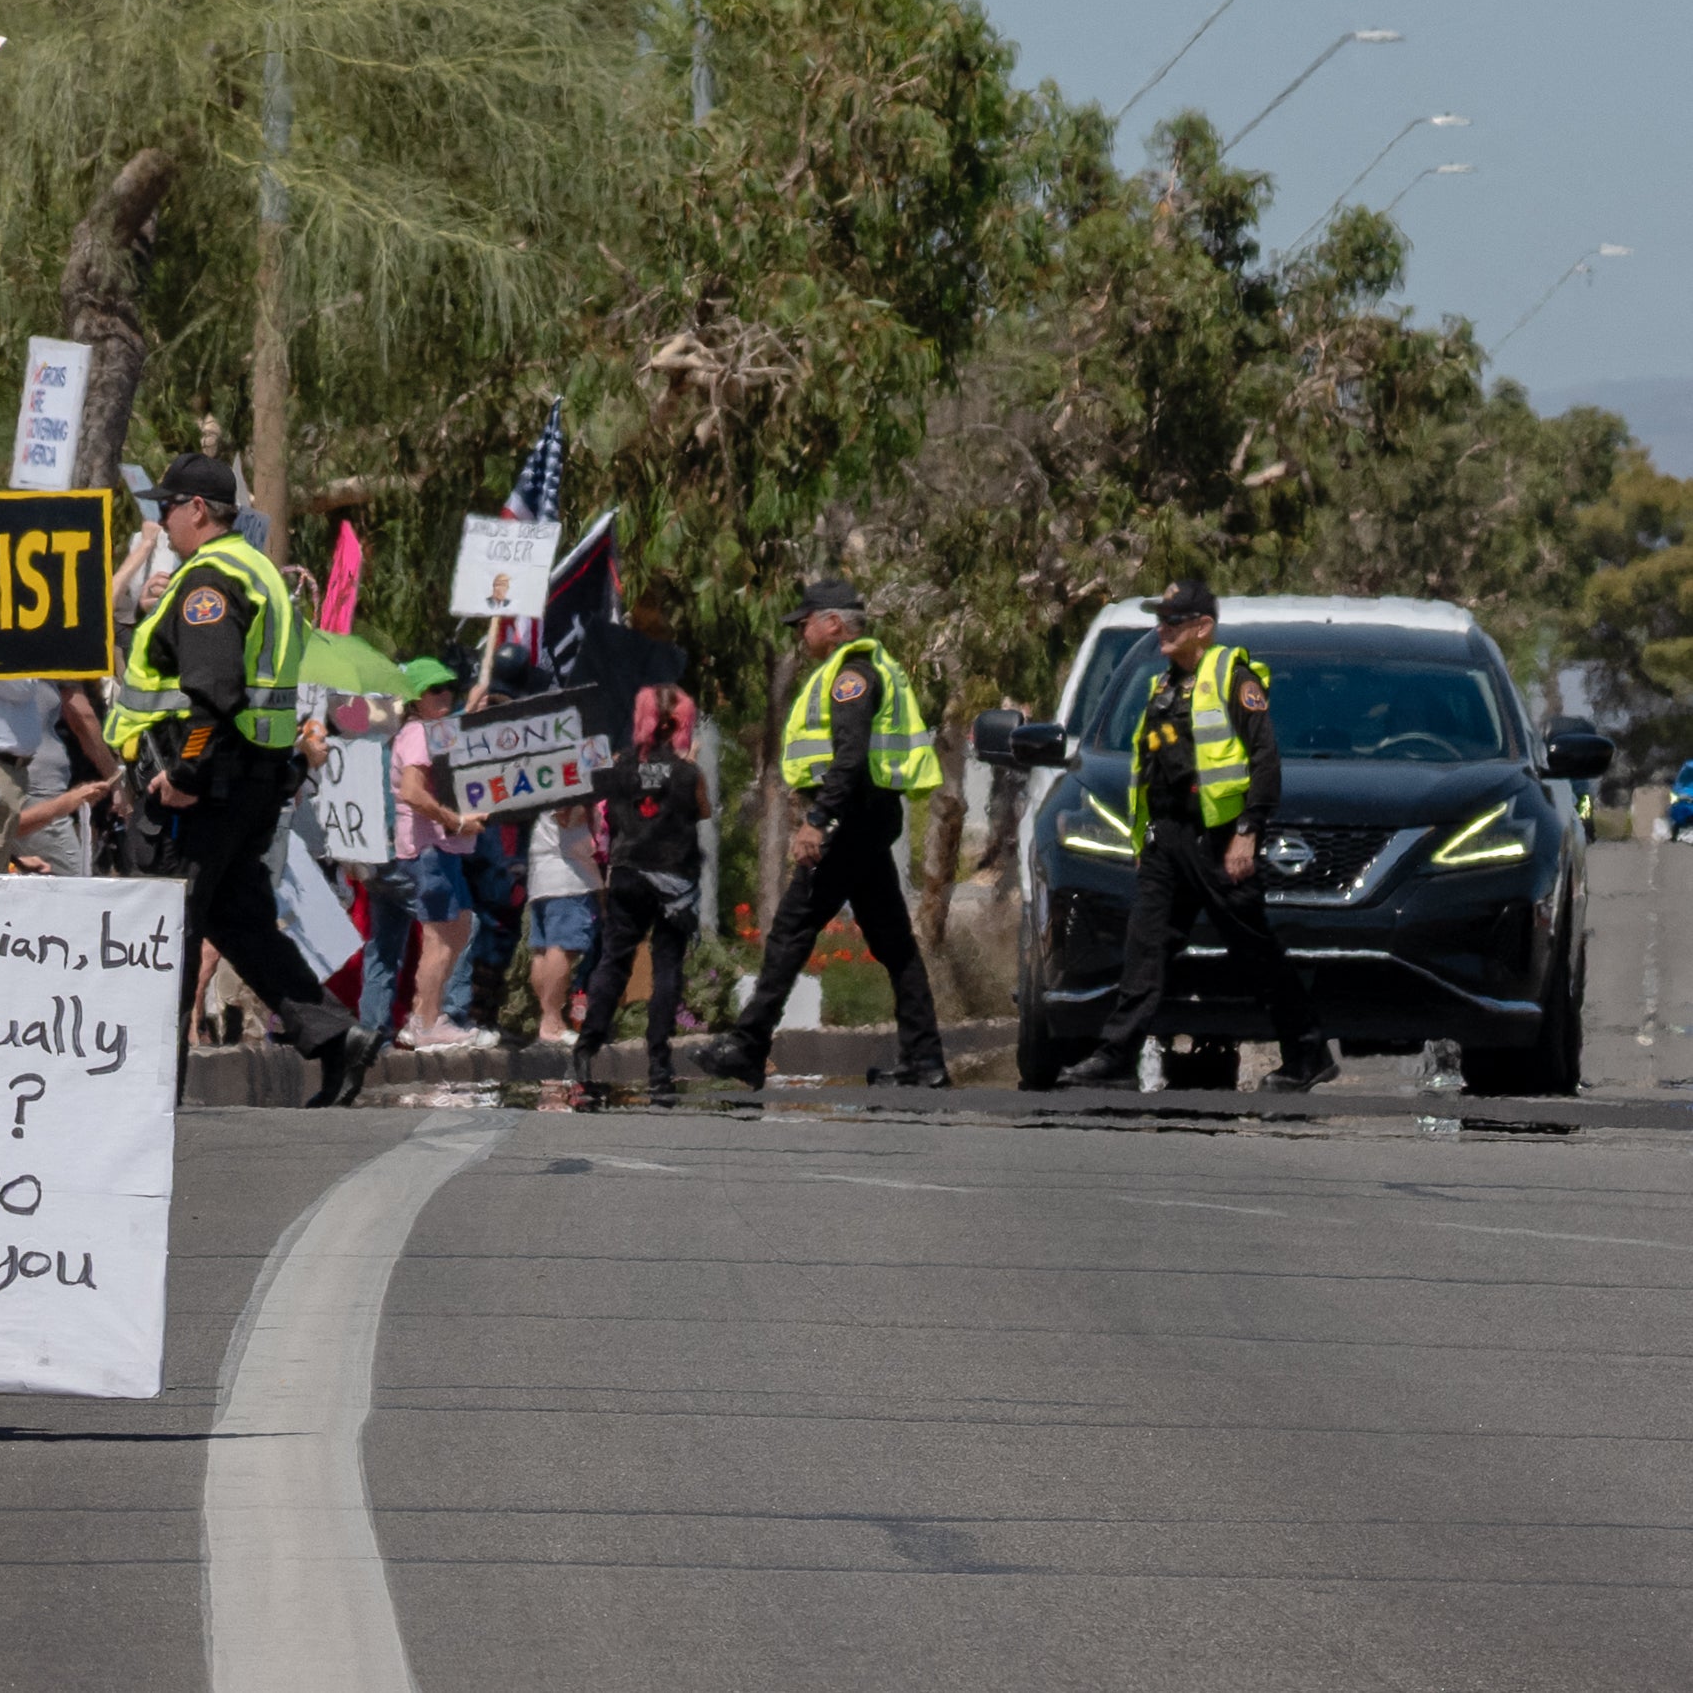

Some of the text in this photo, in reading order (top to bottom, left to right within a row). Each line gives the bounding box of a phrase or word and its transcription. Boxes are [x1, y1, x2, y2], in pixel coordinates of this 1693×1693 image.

[465, 761, 581, 808] PEACE
[325, 801, 368, 849] AR
[100, 910, 175, 972] but
